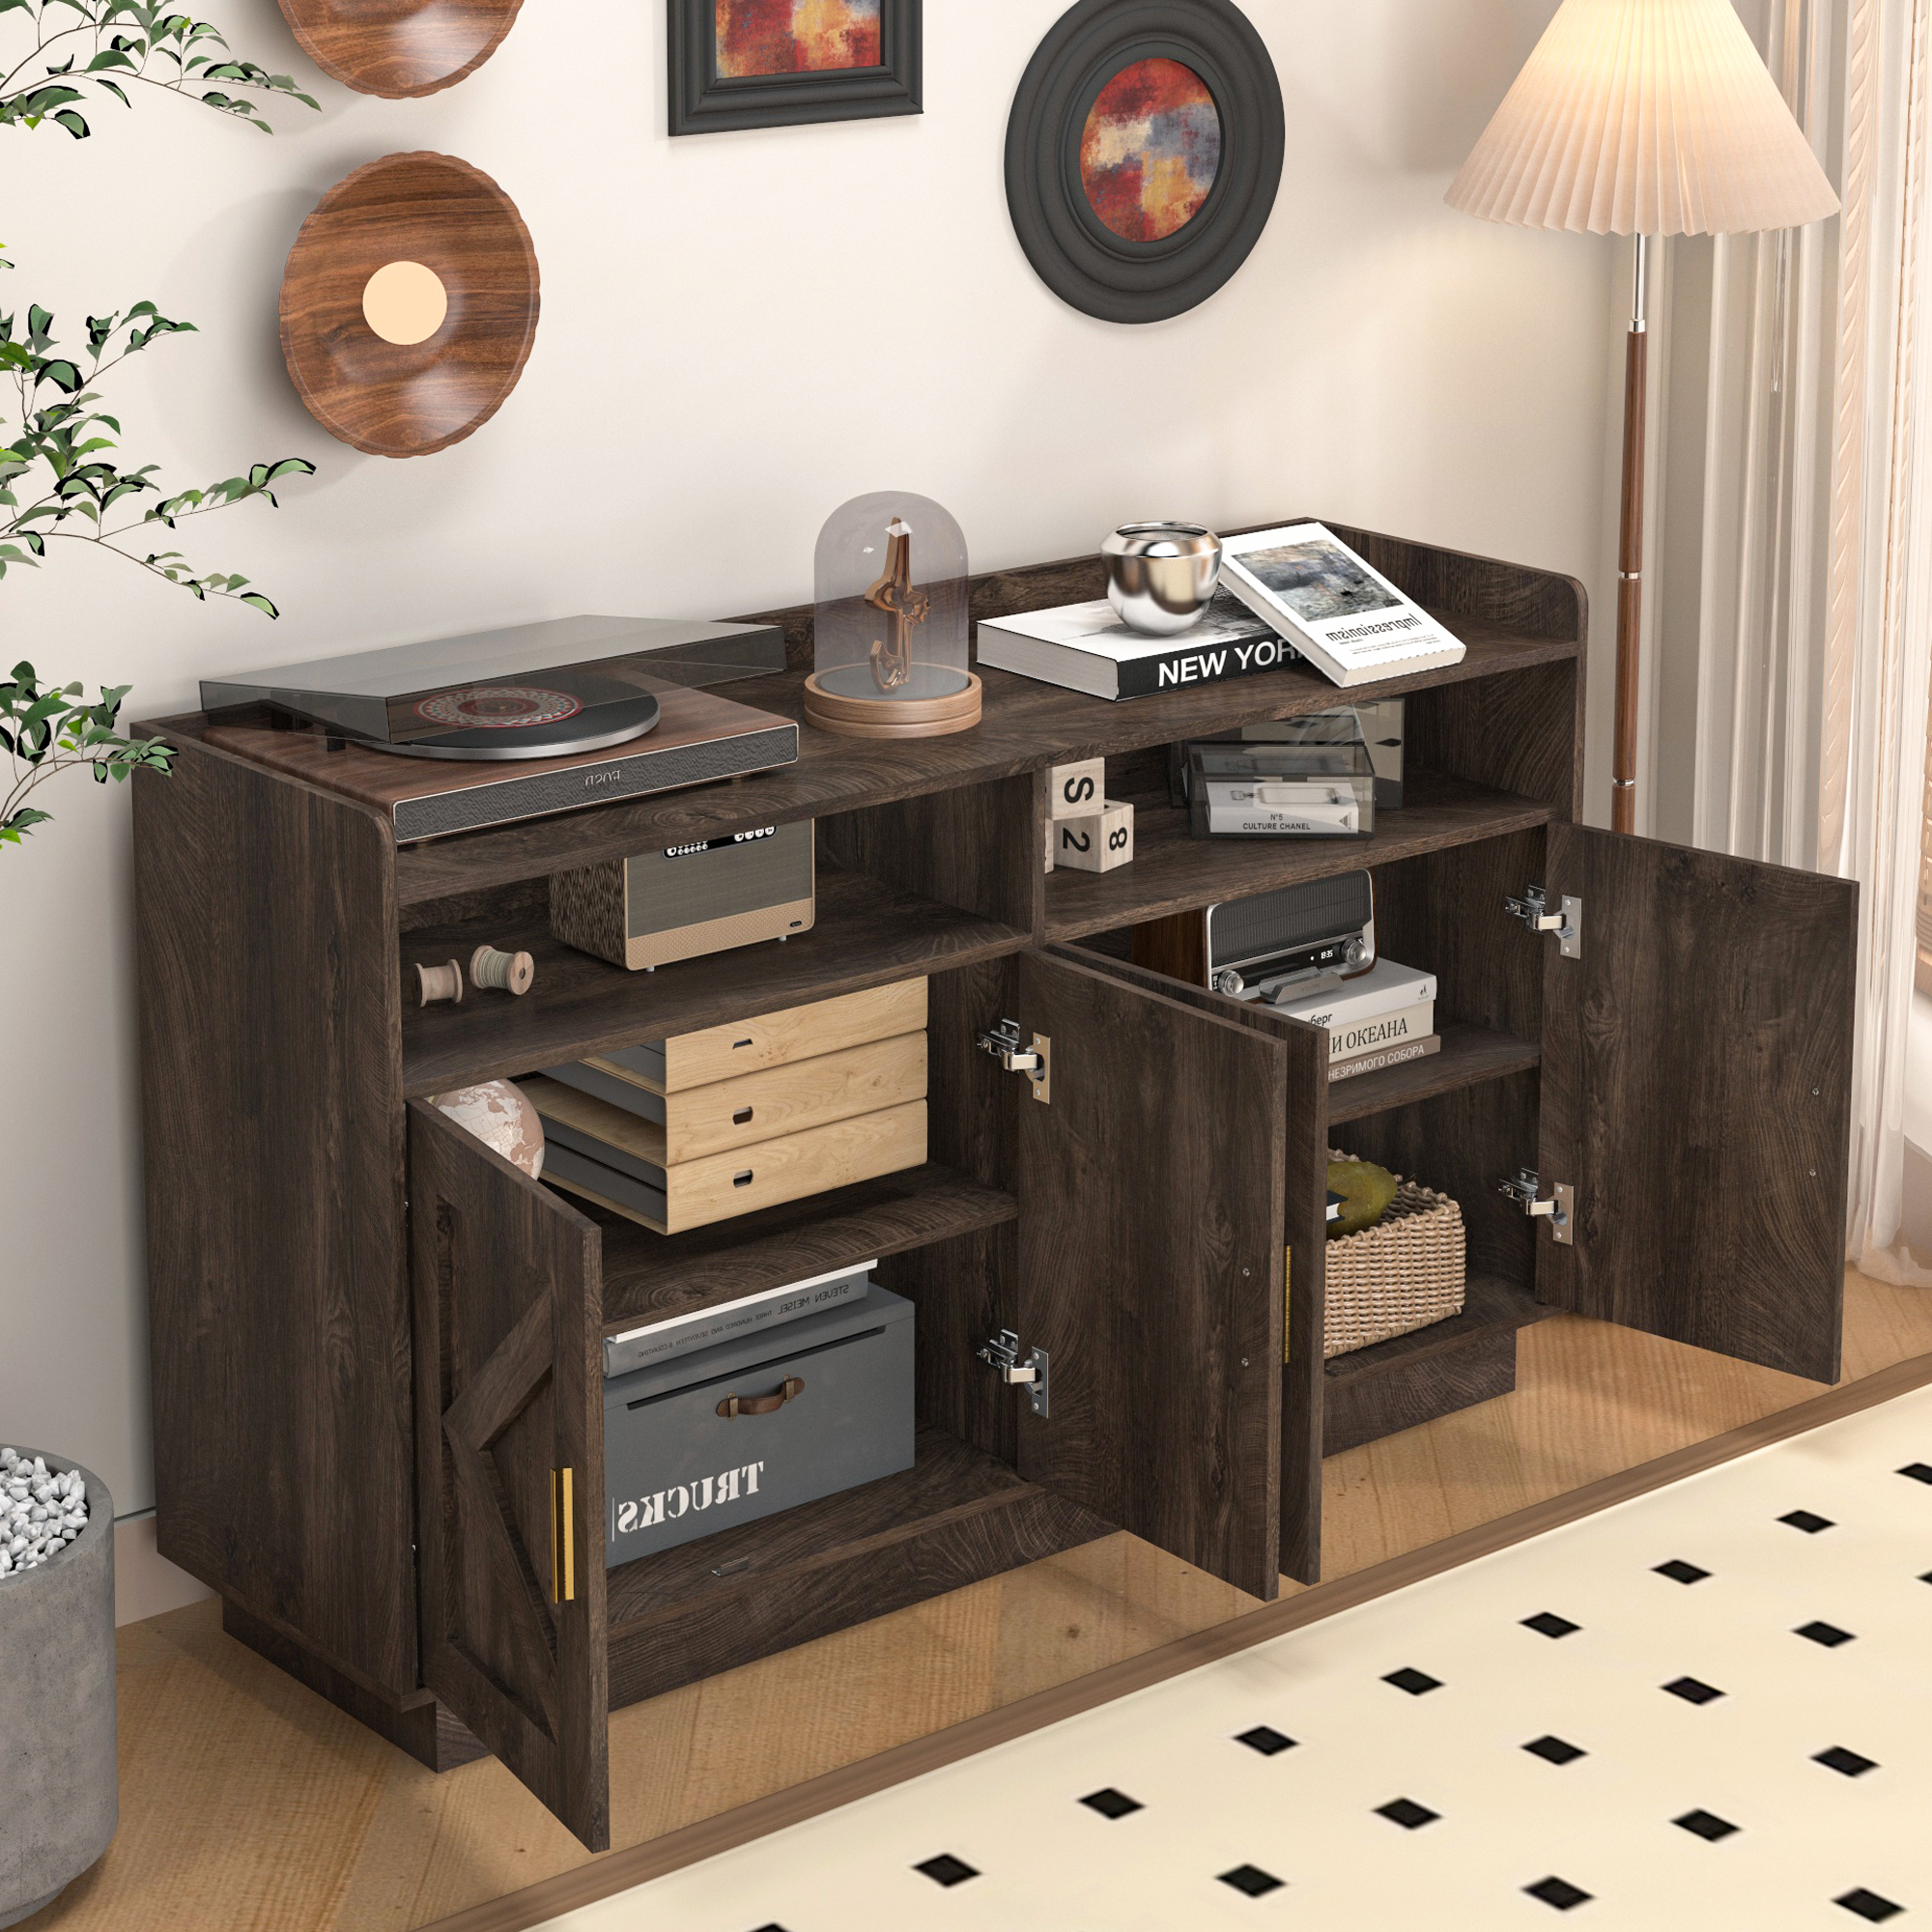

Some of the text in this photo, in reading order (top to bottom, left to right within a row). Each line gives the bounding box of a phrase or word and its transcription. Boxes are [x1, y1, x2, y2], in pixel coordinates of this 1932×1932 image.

[1158, 639, 1304, 687] NEW YOR
[1064, 777, 1094, 804] S
[1063, 827, 1091, 853] 2
[1109, 827, 1127, 851] 8
[1308, 1014, 1332, 1027] берг
[1347, 1018, 1408, 1049] ОКЕАНА
[1328, 1044, 1425, 1081] НЕЗРИМОГО СОБОРА
